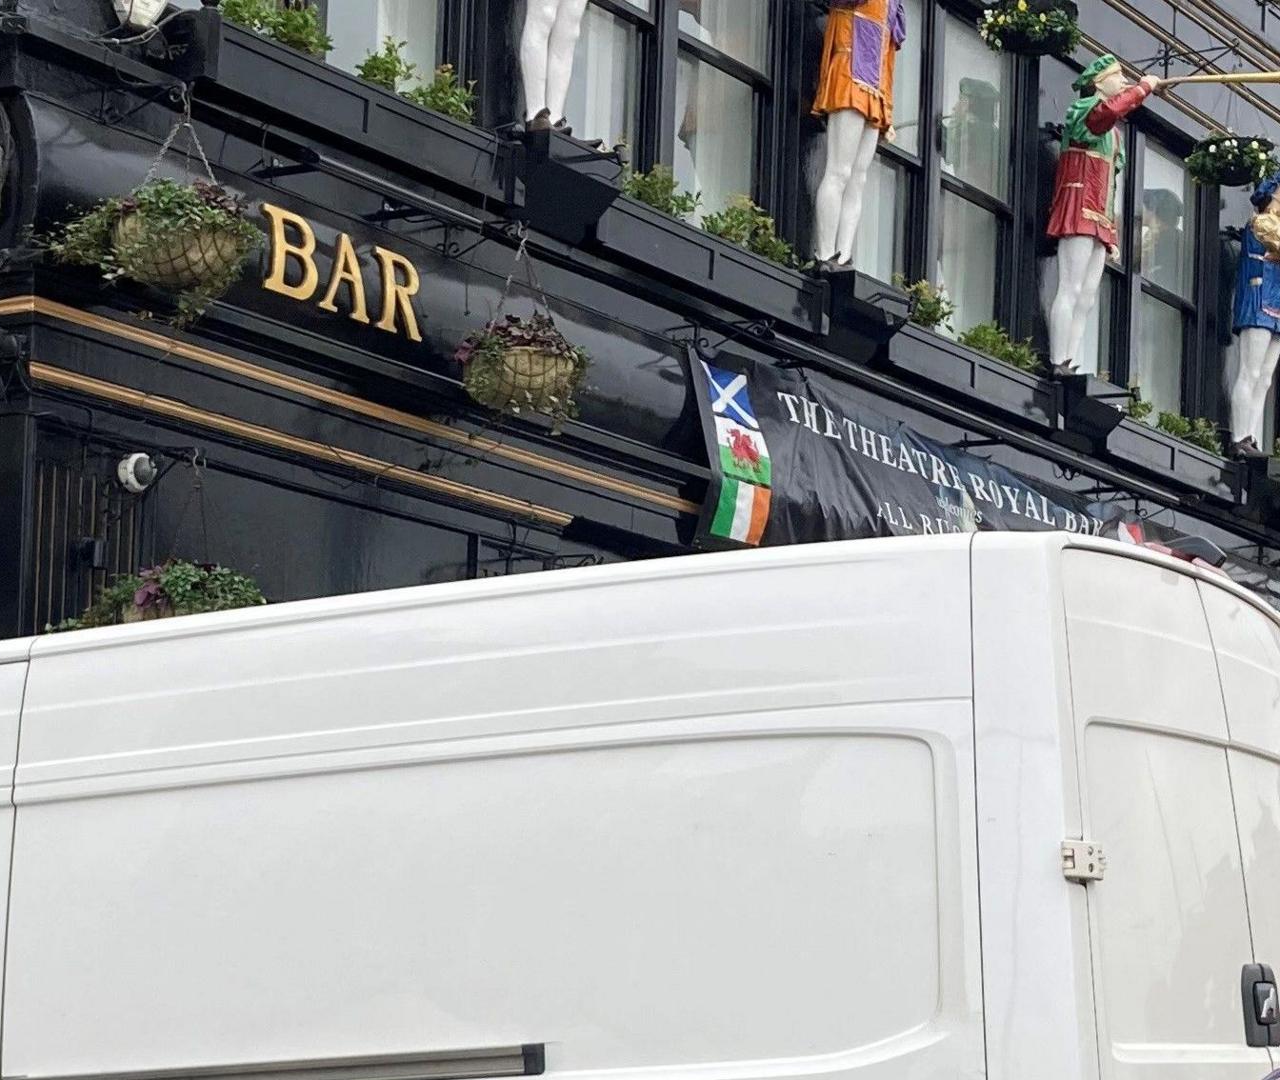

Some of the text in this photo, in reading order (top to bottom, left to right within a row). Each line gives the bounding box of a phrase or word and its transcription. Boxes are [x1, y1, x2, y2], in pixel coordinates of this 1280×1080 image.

[260, 203, 423, 342] BAR
[777, 392, 1104, 536] THE THEATRE ROYAL BAR
